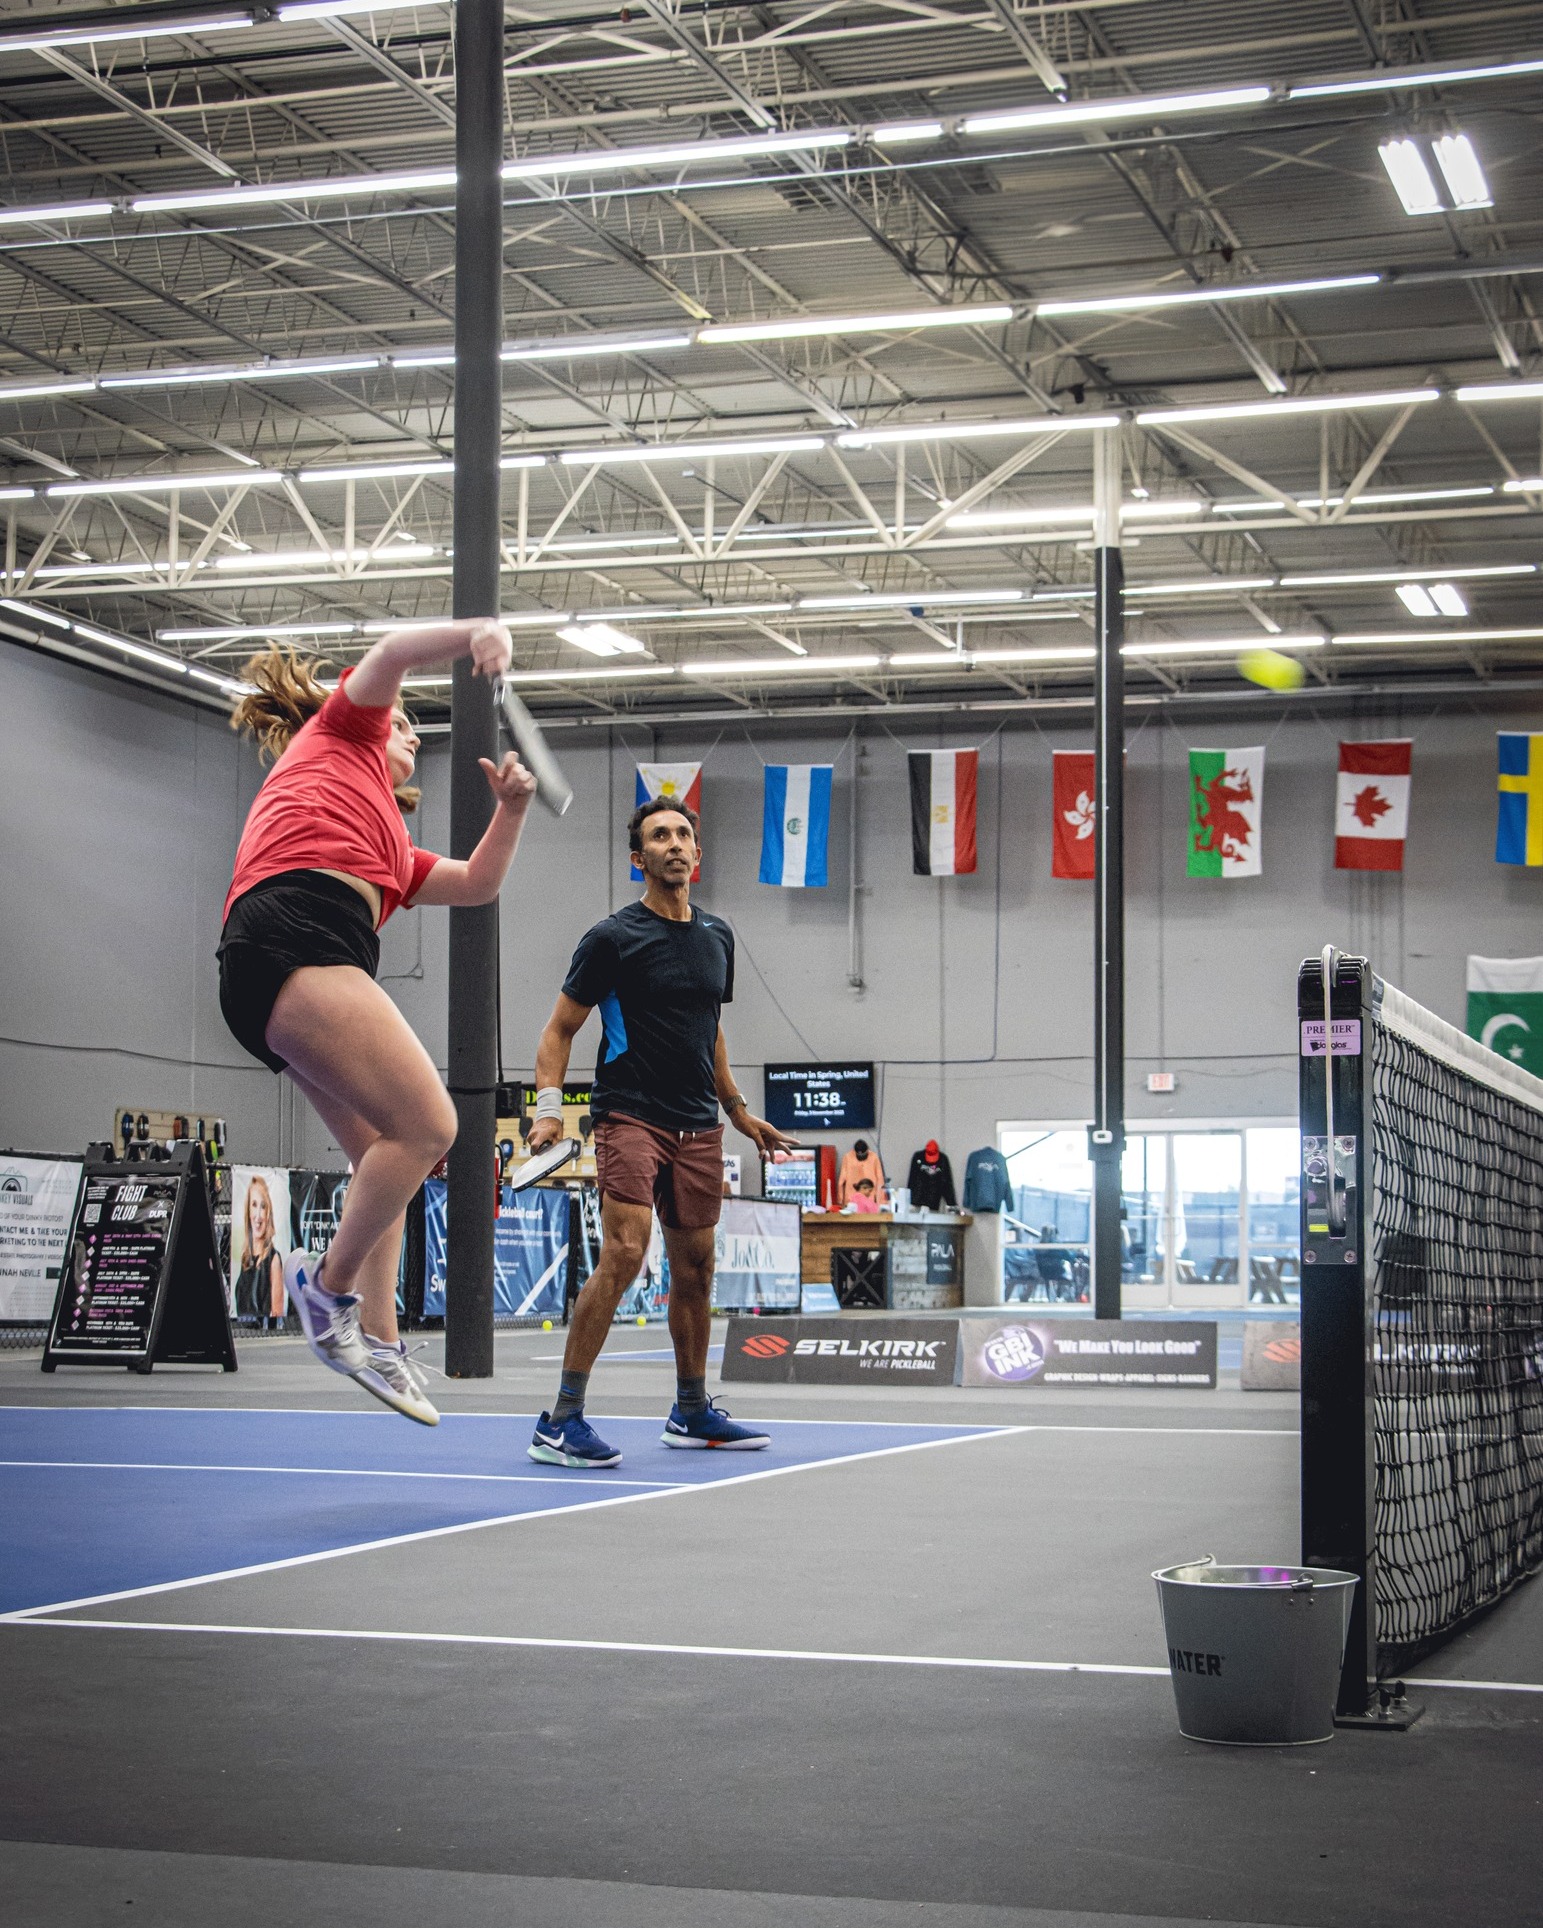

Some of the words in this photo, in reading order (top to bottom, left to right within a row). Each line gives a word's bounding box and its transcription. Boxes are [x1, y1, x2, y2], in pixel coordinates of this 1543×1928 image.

[769, 1072, 788, 1080] Local
[789, 1071, 807, 1079] Time
[808, 1070, 816, 1079] in
[817, 1070, 843, 1080] Spring,
[843, 1070, 868, 1079] United
[806, 1080, 831, 1088] States
[793, 1092, 840, 1107] 11:38
[115, 1185, 148, 1202] FIGHT
[111, 1205, 138, 1220] CLUB
[149, 1210, 167, 1218] DUPR
[19, 1226, 29, 1234] ME
[31, 1227, 35, 1235] &
[52, 1228, 67, 1236] YOUR
[28, 1238, 37, 1246] TO
[793, 1339, 939, 1357] SELKIRK
[859, 1359, 873, 1369] WE
[874, 1359, 889, 1369] ARE
[890, 1359, 936, 1370] PICKLEBALL
[994, 1349, 1041, 1375] INK
[1044, 1372, 1073, 1382] GRAPHIC
